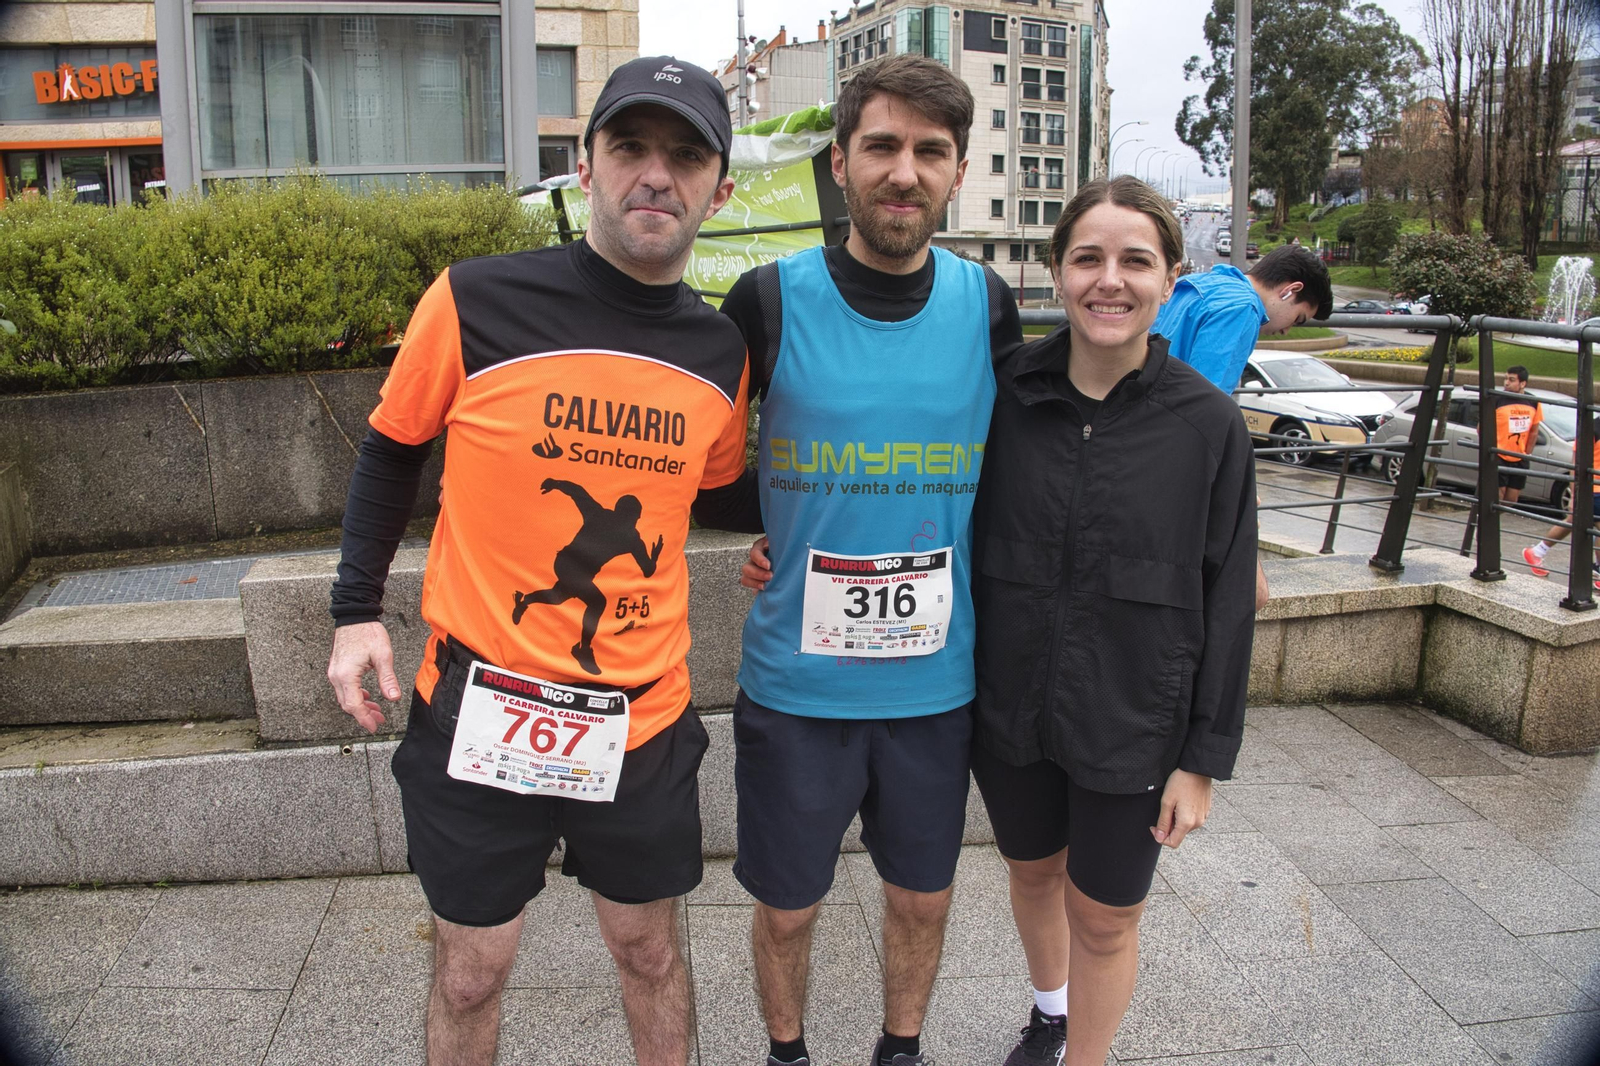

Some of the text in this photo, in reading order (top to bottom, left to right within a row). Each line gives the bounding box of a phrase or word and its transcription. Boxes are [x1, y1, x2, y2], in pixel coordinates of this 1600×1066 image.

[544, 392, 686, 446] CALVARIO
[568, 442, 686, 475] Santander
[770, 475, 818, 492] alquiler
[825, 482, 834, 495] y
[840, 481, 890, 494] venta
[896, 480, 916, 494] de
[846, 577, 890, 585] CARREIRA
[891, 572, 928, 583] CALVARIO
[615, 595, 650, 619] 5+5
[844, 583, 916, 618] 316
[493, 694, 606, 724] VII CARREIRA CALVARIO
[501, 706, 590, 757] 767
[493, 743, 510, 752] Oscar
[510, 746, 545, 760] DOMINGUEZ
[545, 754, 573, 764] SERRANO
